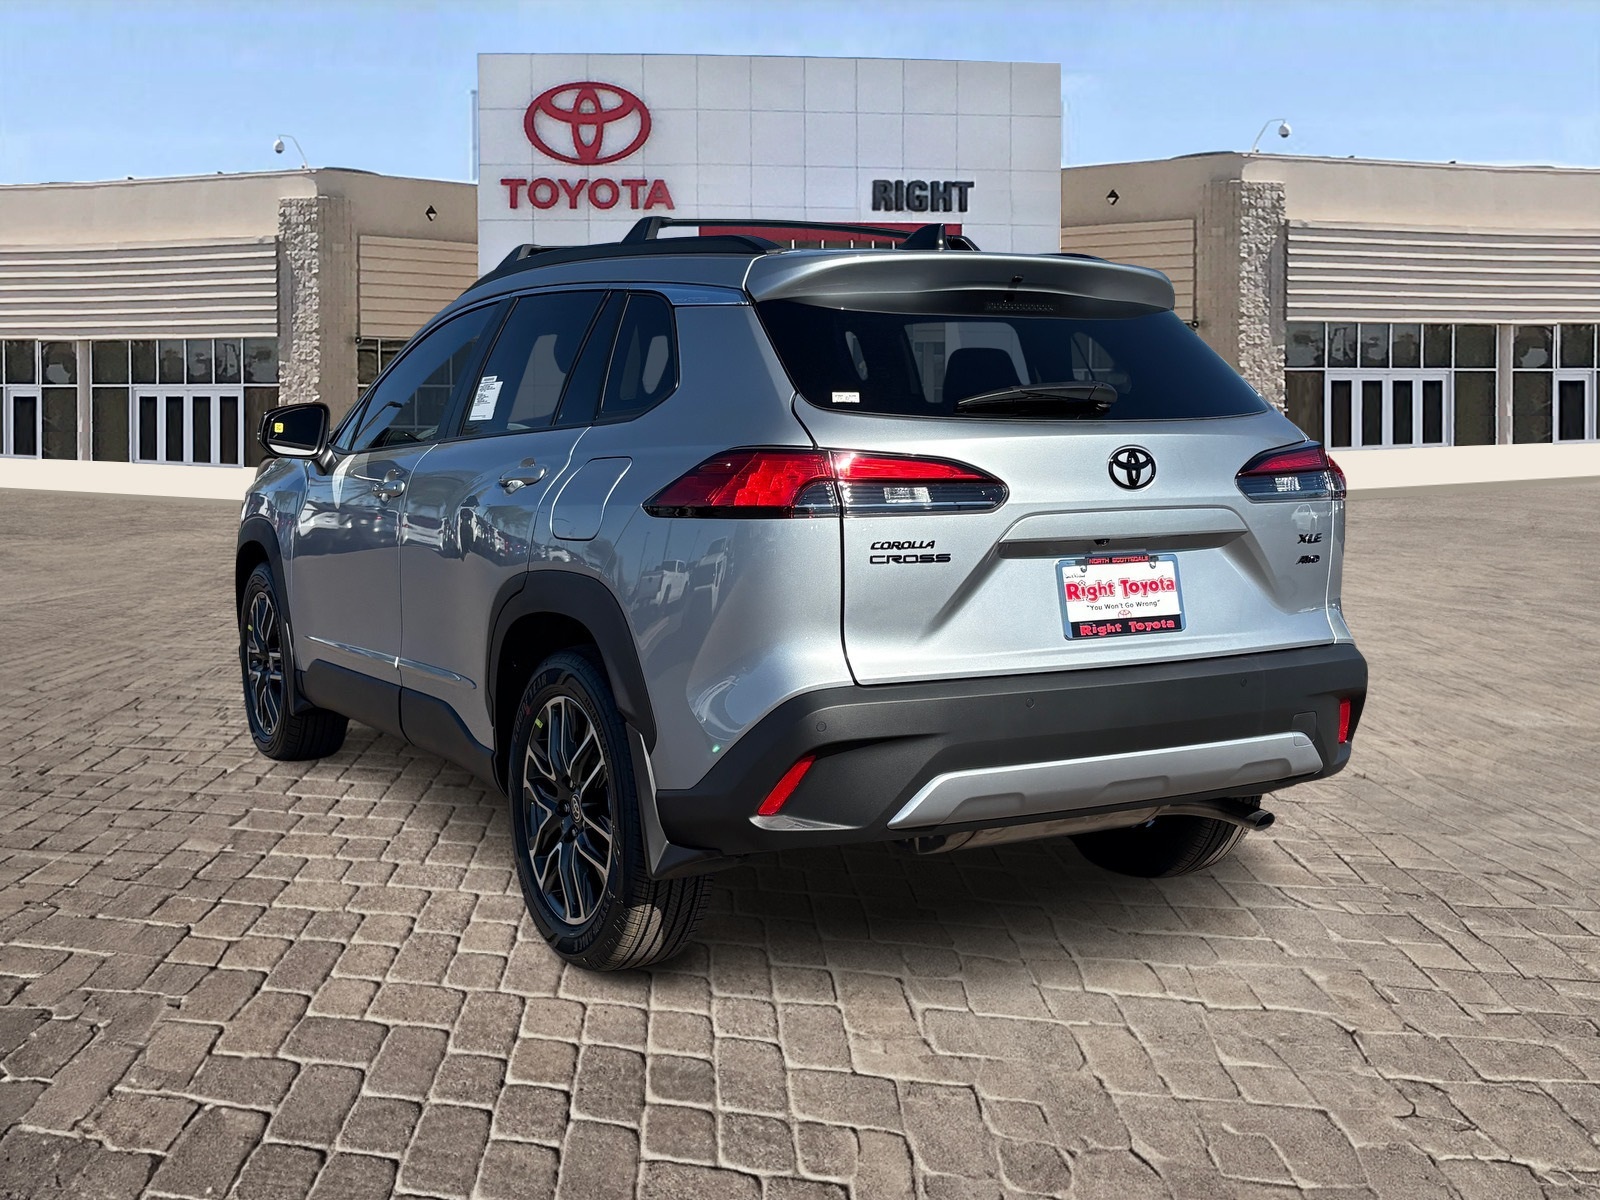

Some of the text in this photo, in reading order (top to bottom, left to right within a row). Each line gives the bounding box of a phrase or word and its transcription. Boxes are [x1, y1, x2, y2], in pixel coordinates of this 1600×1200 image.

[500, 178, 675, 209] TOYOTA
[872, 179, 975, 212] RIGHT
[1297, 532, 1323, 544] XLE
[870, 540, 935, 550] COROLLA
[869, 553, 951, 564] CROSS
[1065, 577, 1176, 603] Right Toyota
[1124, 601, 1135, 609] Go
[1080, 620, 1175, 635] Right Toyota
